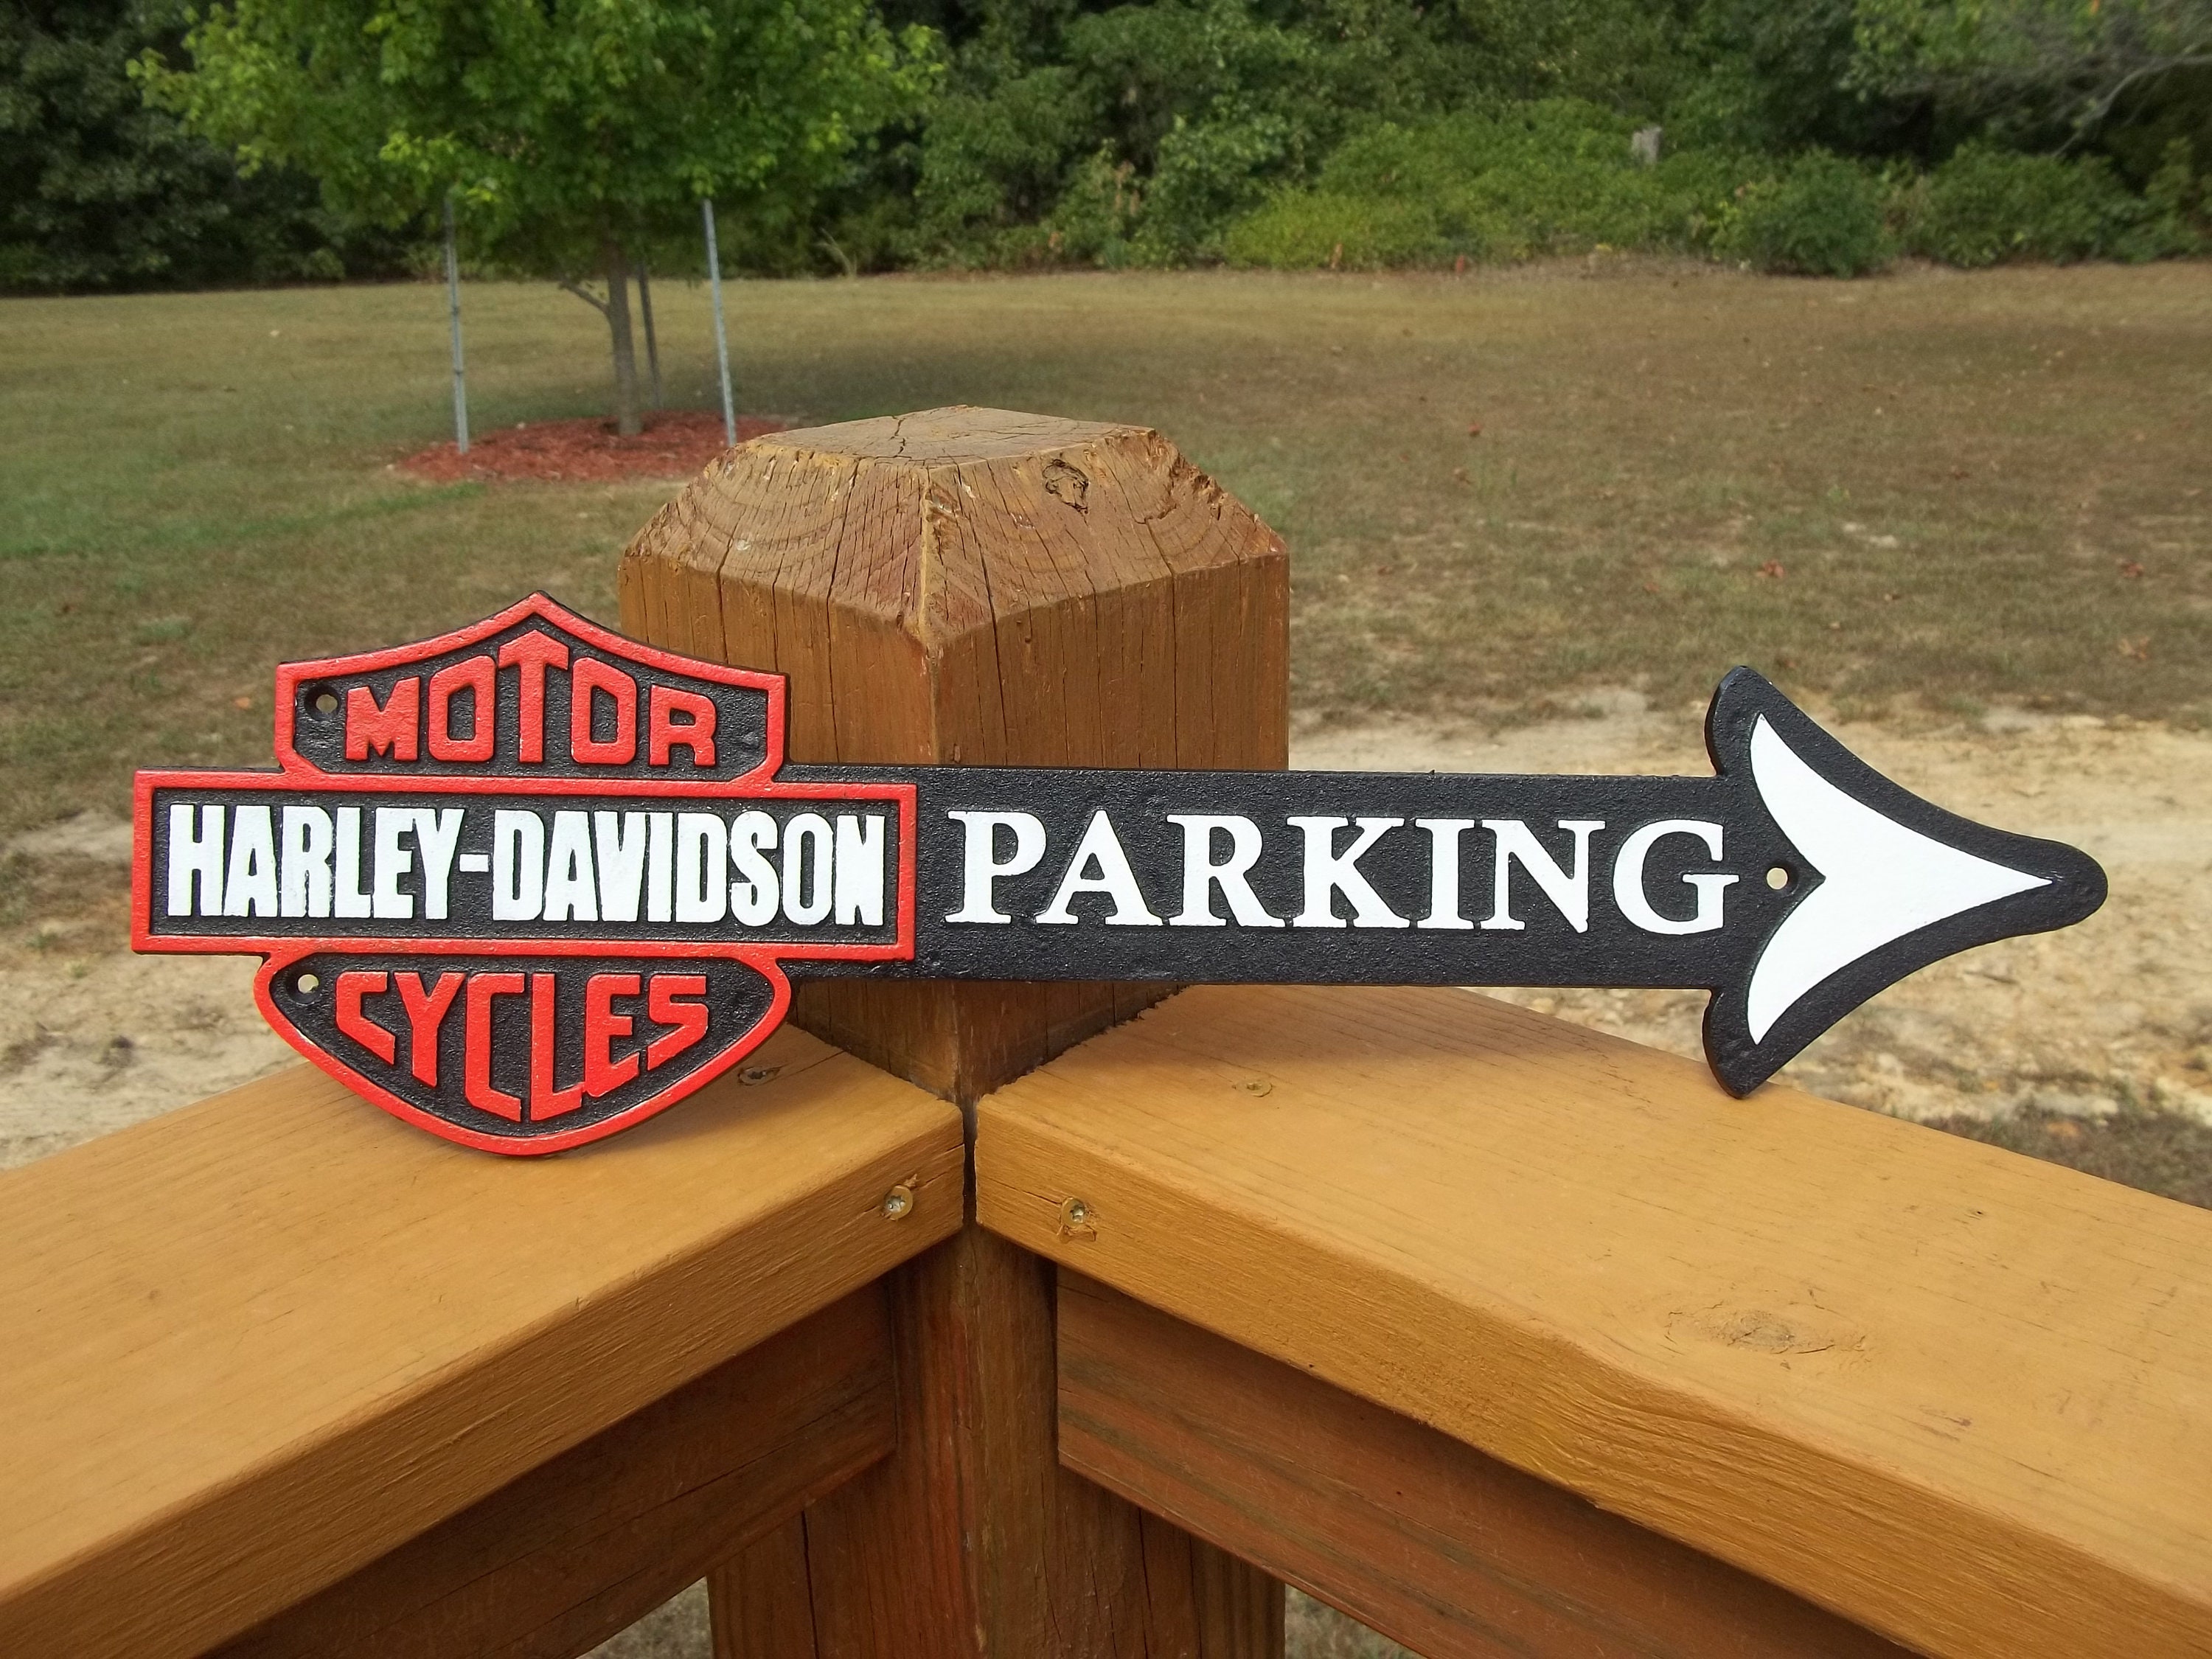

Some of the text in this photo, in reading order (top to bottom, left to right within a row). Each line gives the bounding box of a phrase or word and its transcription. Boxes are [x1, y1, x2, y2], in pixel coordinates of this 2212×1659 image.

[345, 629, 717, 767] MOTOR
[167, 803, 886, 928] HARLEY-DAVIDSON
[945, 809, 1740, 936] PARKING
[335, 970, 709, 1123] CYCLES
